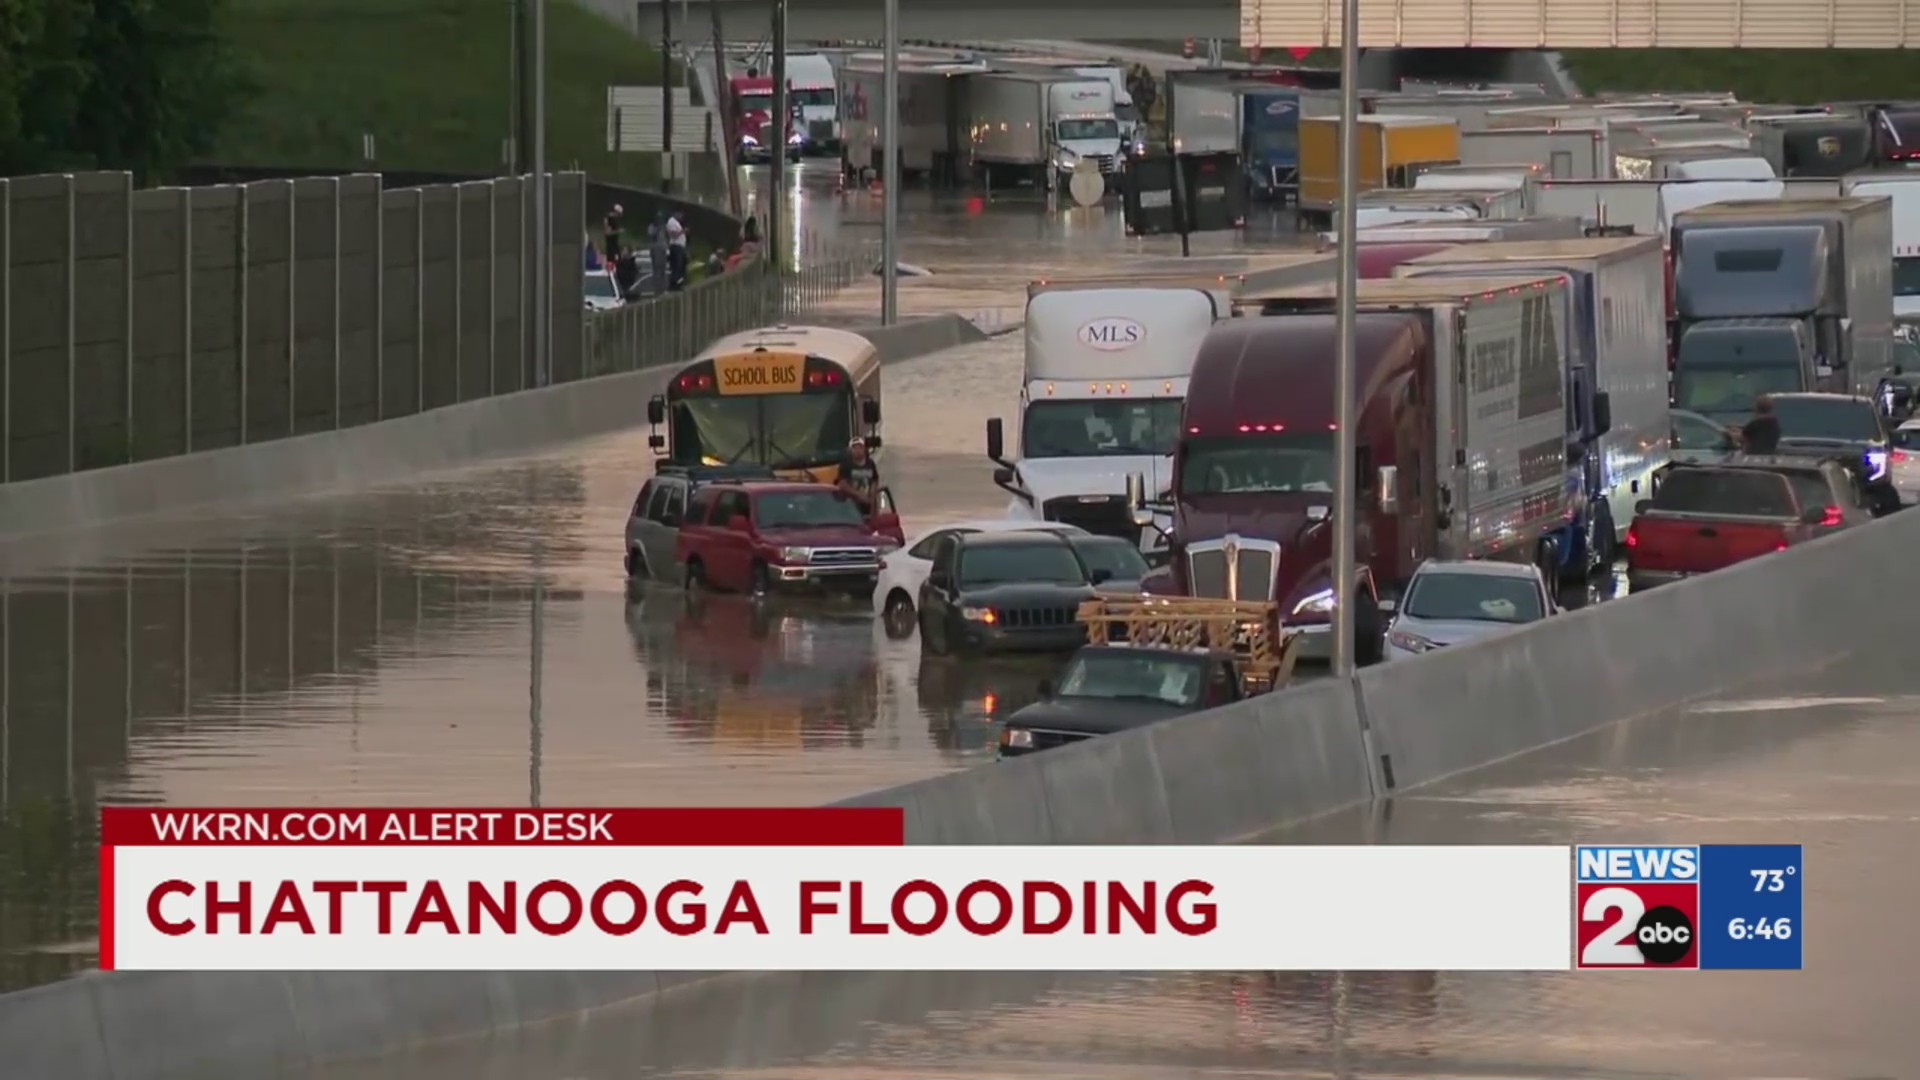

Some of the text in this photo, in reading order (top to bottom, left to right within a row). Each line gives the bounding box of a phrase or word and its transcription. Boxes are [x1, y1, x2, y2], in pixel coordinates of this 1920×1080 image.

[1087, 324, 1138, 343] MLS
[723, 365, 796, 386] SCHOOL BUS
